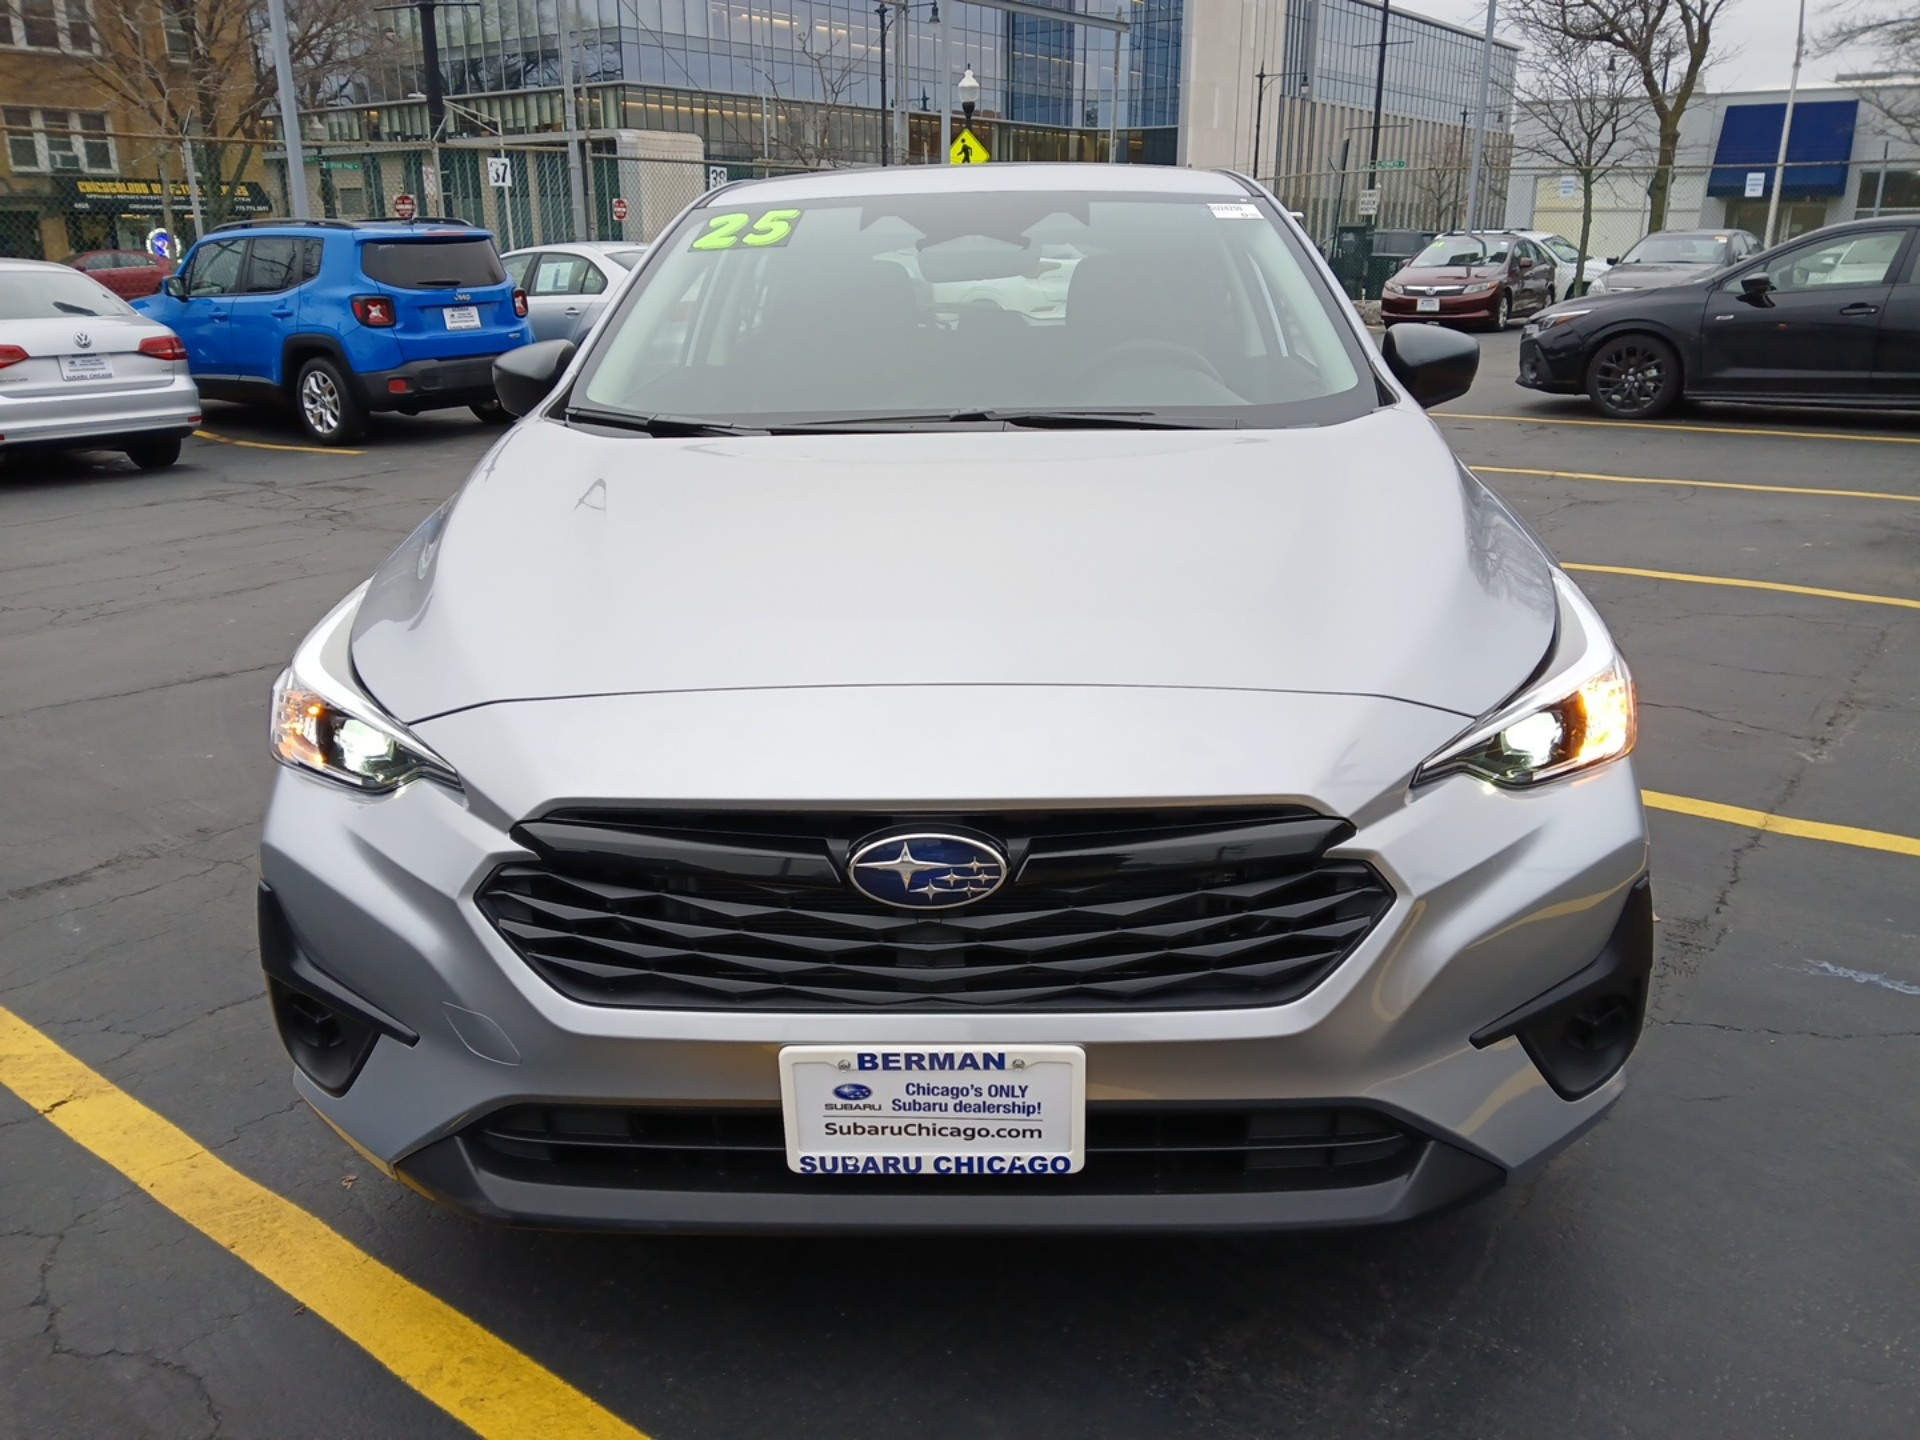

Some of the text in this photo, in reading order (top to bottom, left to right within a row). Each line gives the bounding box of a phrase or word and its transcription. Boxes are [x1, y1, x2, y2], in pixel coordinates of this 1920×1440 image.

[489, 161, 508, 183] 37
[692, 208, 801, 250] 25
[856, 1052, 1006, 1071] BERMAN
[905, 1082, 1029, 1100] Chicago's ONLY
[824, 1103, 882, 1112] SUBARU
[891, 1098, 1042, 1117] Subaru dealership!
[824, 1121, 1043, 1141] SubaruChicago.com
[800, 1155, 1072, 1175] SUBARU CHICAGO
